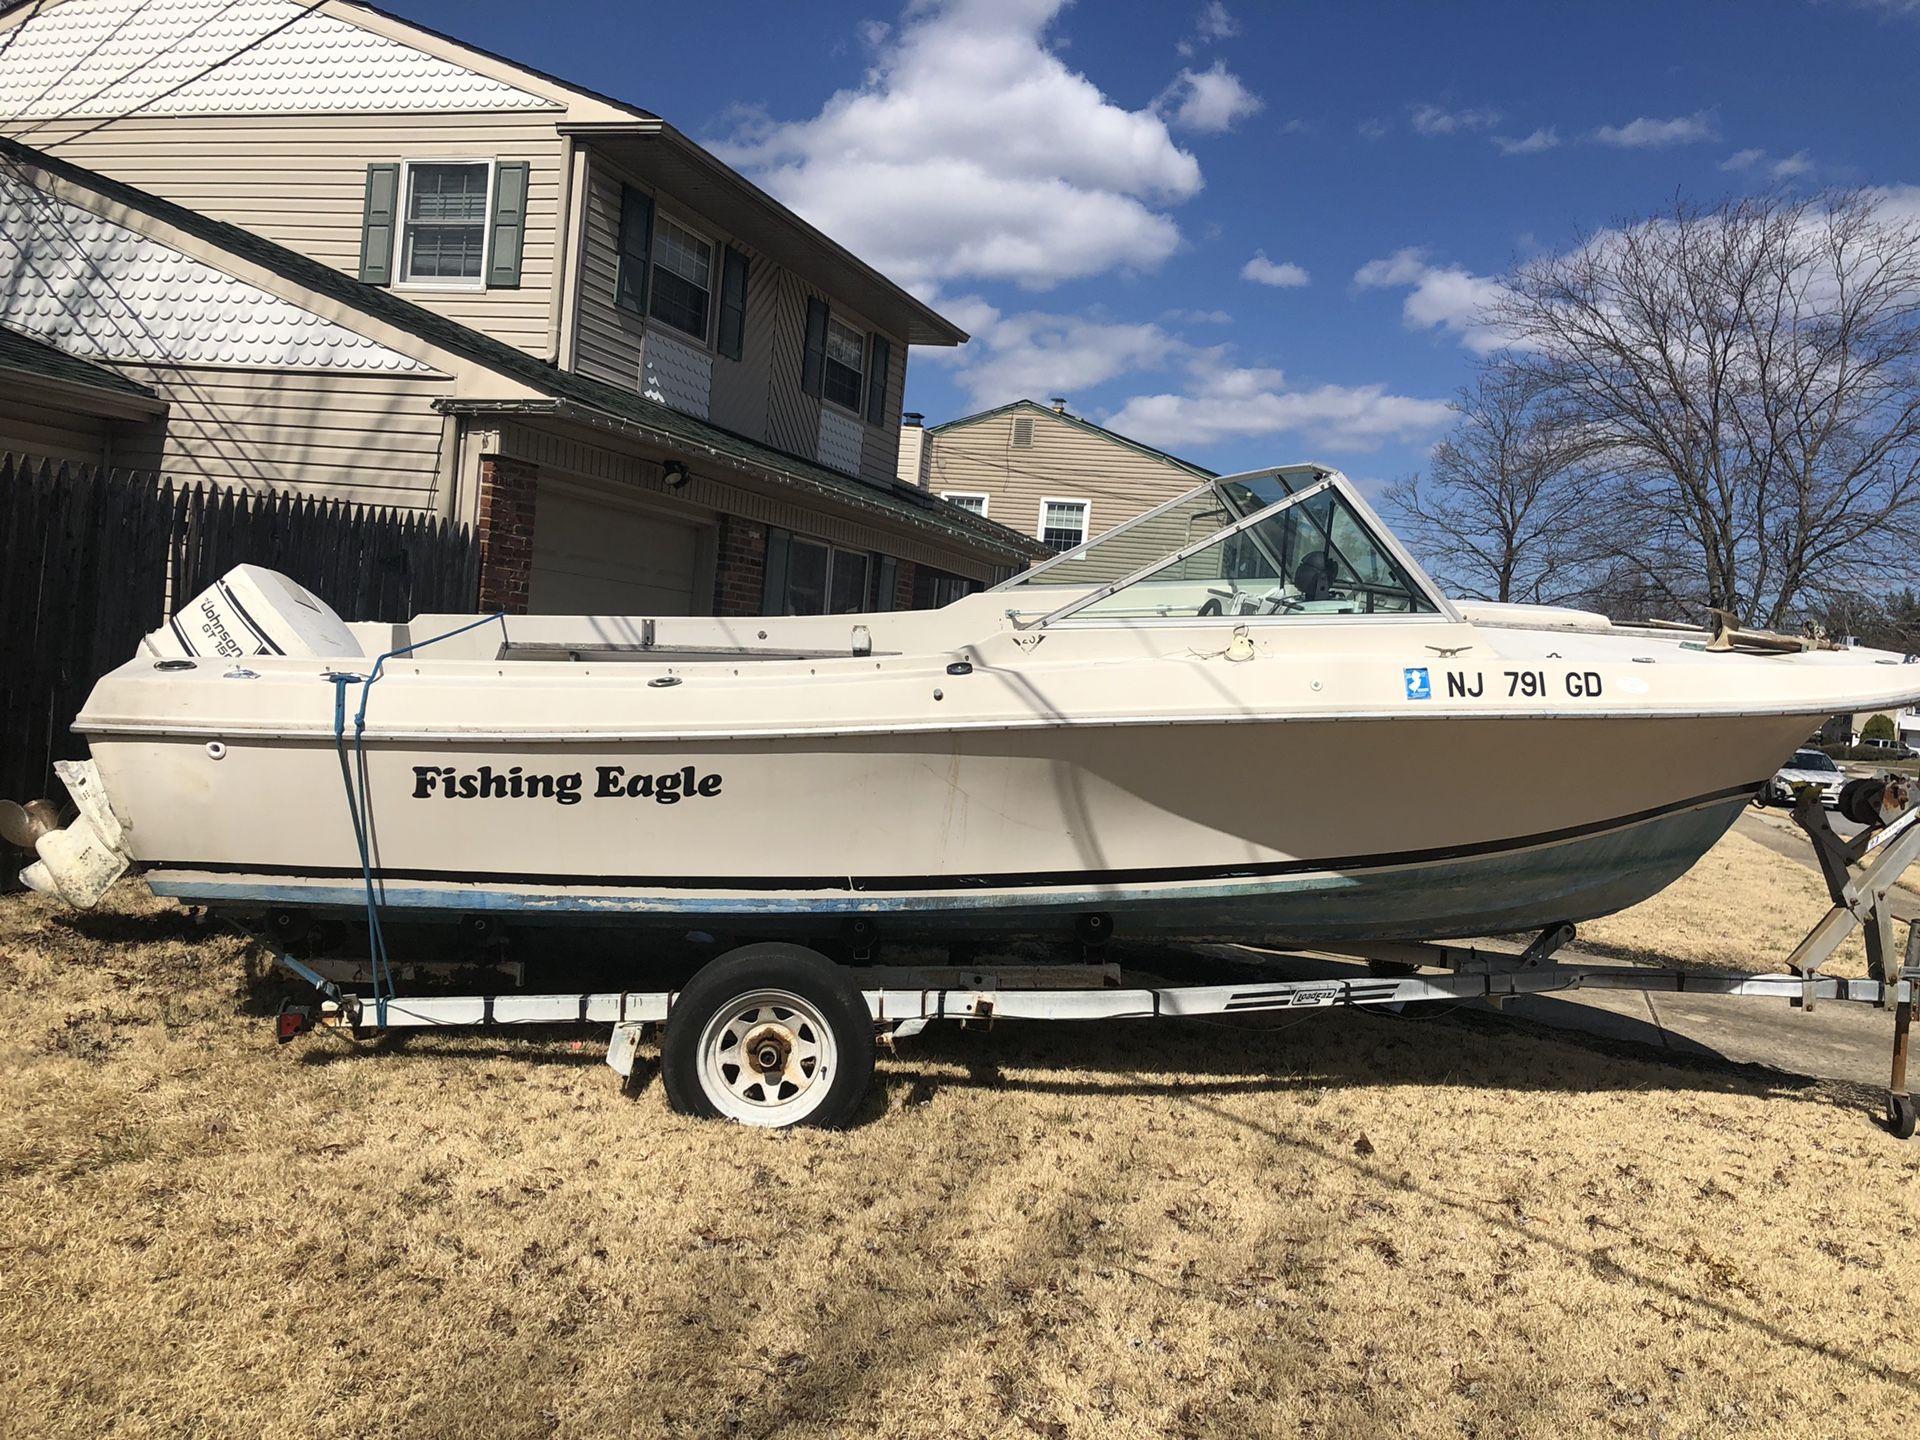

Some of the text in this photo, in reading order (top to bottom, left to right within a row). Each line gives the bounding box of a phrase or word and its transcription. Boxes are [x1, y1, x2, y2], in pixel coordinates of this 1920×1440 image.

[201, 603, 243, 657] Johnson
[202, 624, 217, 638] GT
[1447, 671, 1484, 698] NJ
[1504, 671, 1546, 697] 791
[1565, 671, 1603, 698] GD
[412, 766, 723, 805] Fishing Eagle
